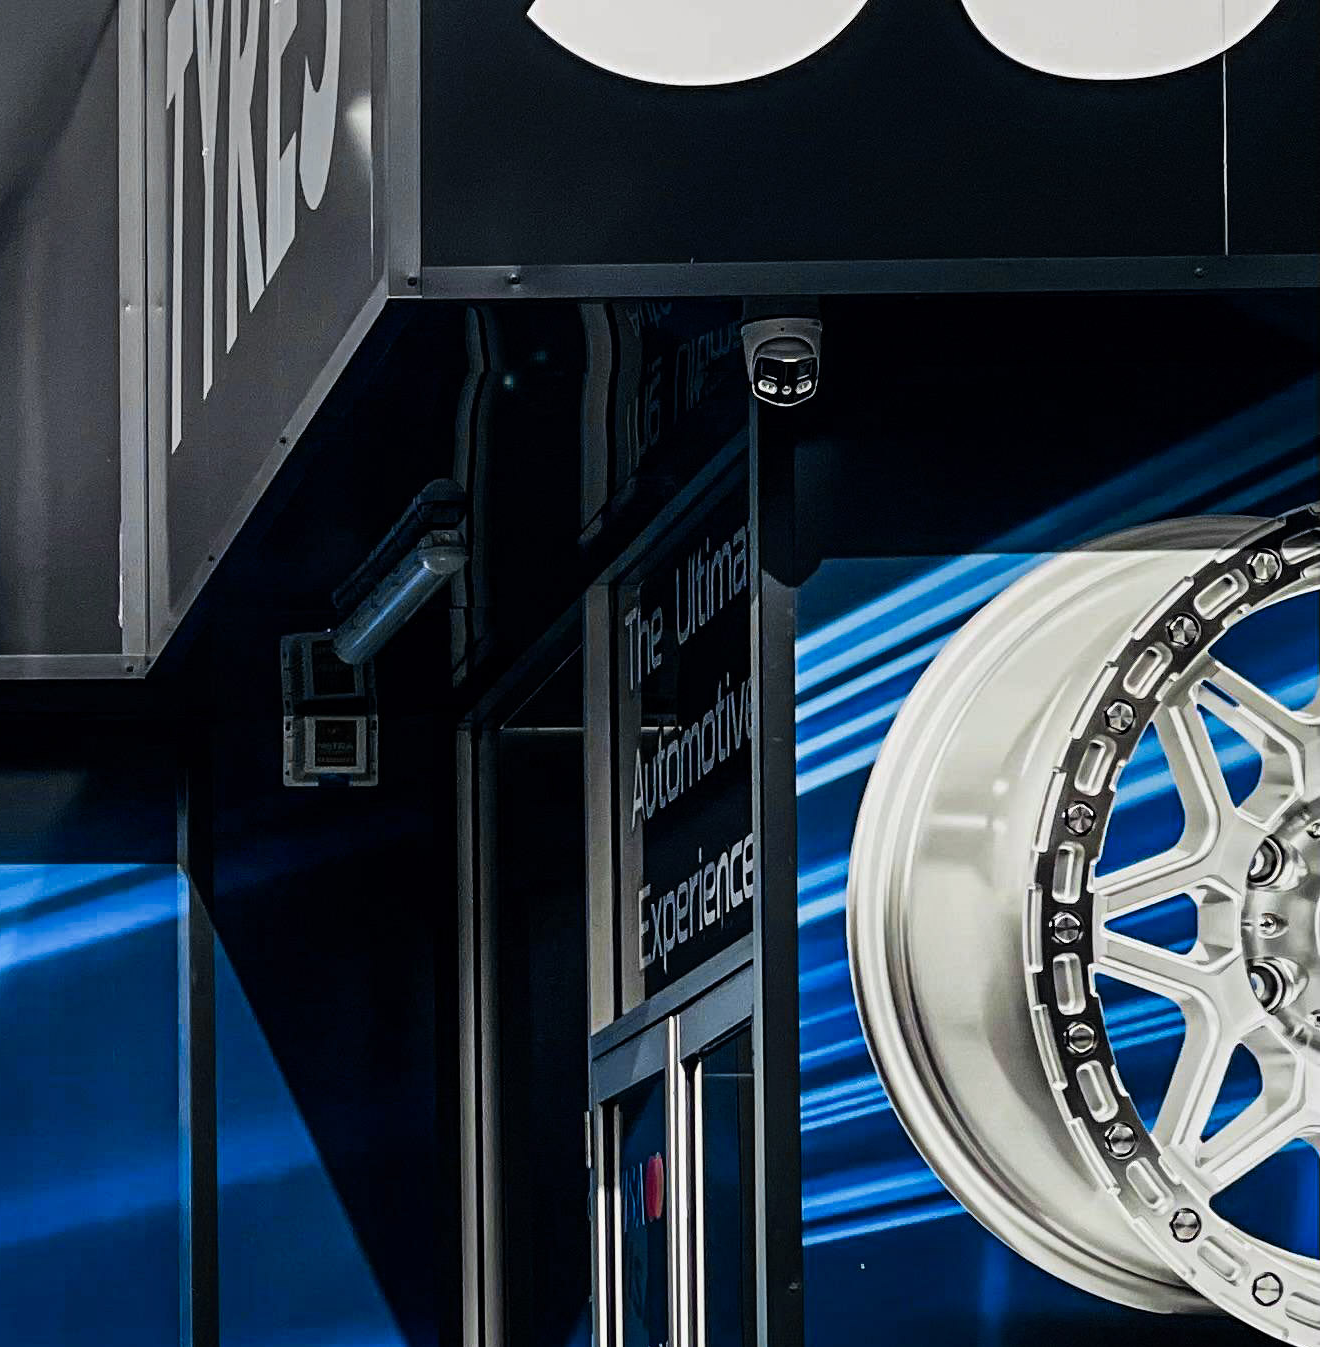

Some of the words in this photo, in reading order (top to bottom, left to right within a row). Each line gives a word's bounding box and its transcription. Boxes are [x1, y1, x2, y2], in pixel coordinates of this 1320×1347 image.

[624, 603, 664, 692] The
[675, 522, 755, 647] Ultima
[637, 831, 755, 973] Experience
